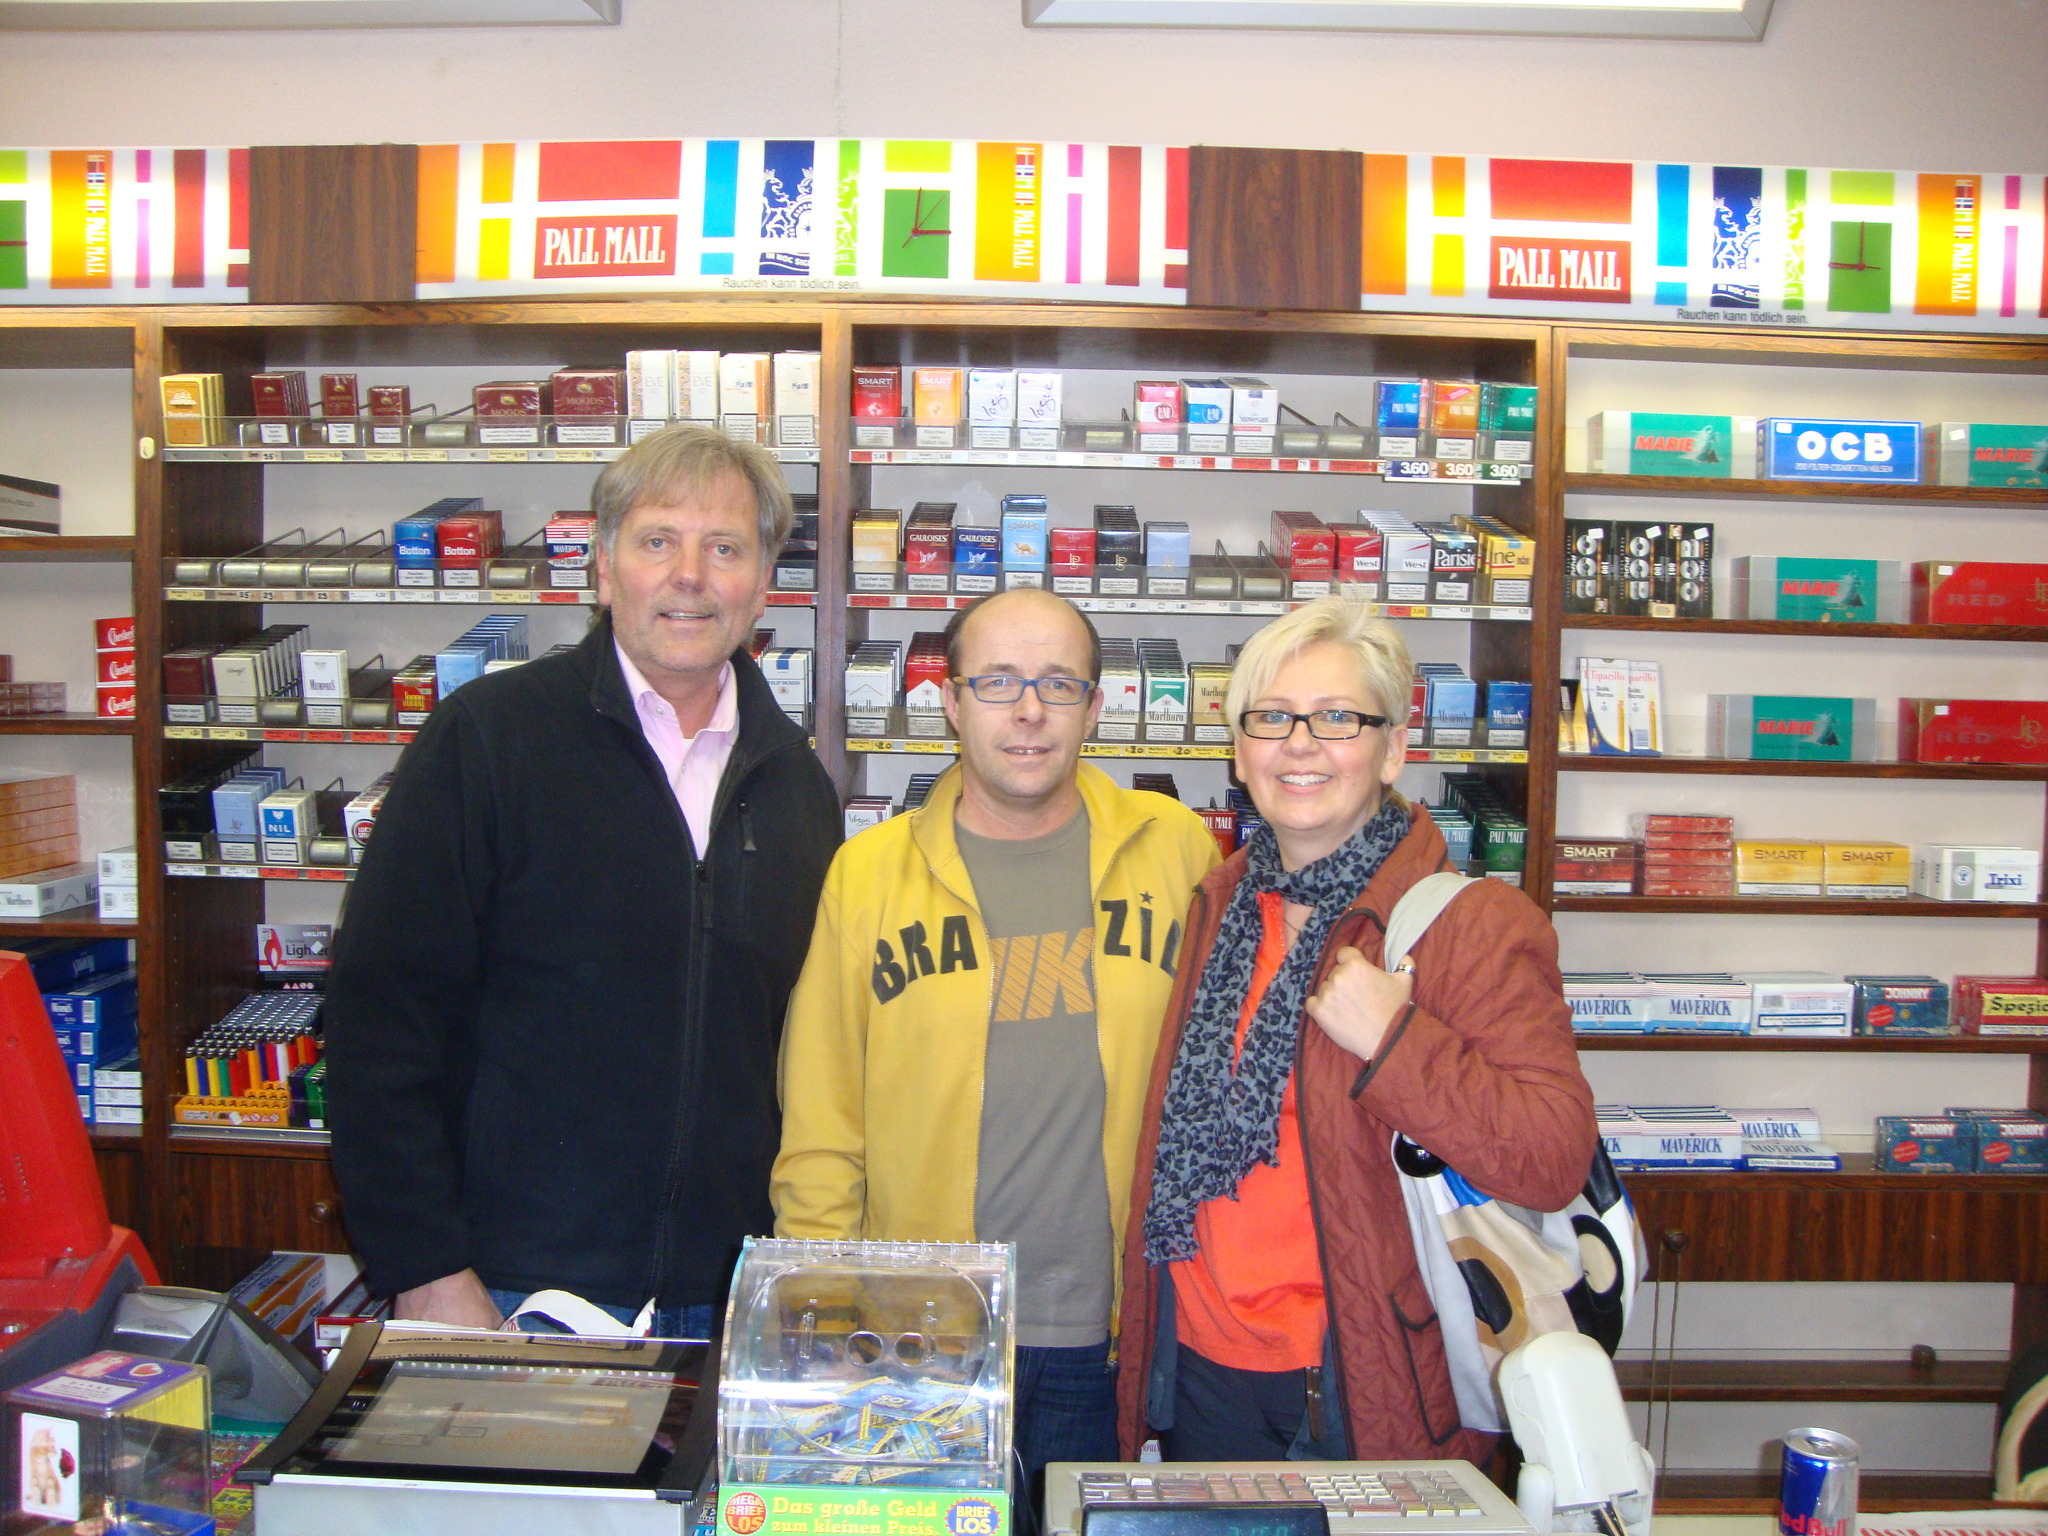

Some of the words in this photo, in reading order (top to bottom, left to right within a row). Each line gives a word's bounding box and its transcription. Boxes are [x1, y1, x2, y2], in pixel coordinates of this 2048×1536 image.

[86, 217, 106, 244] PALL
[1013, 210, 1035, 237] PALL
[544, 227, 599, 266] PALL
[604, 225, 665, 264] MALL
[1013, 238, 1034, 268] MALL
[1952, 243, 1974, 270] PALL
[86, 246, 106, 276] MALL
[1499, 247, 1555, 288] PALL
[1560, 249, 1621, 291] MALL
[722, 277, 767, 290] Rauchen
[771, 278, 797, 290] kann
[800, 278, 834, 290] tödlich
[838, 279, 862, 290] sein.
[1951, 273, 1973, 303] MALL
[1677, 308, 1719, 320] Rauchen
[1723, 310, 1746, 321] kann
[1750, 310, 1782, 323] tödlich
[1786, 314, 1808, 324] sein.
[1636, 436, 1695, 452] MARIE
[1797, 430, 1893, 461] OCB
[1975, 447, 2035, 463] MARIE
[910, 534, 948, 542] GAULOISES
[959, 534, 996, 542] GAULOISES
[1404, 560, 1427, 568] West
[1782, 581, 1840, 596] MARIE
[1949, 594, 2006, 606] RED
[309, 680, 335, 691] MEMPHIS
[852, 699, 886, 713] Marlboro
[1105, 703, 1135, 716] Marlboro
[1150, 707, 1184, 722] Marlboro
[1493, 709, 1524, 724] MEMPHIS
[1757, 720, 1815, 734] MARIE
[1937, 732, 1994, 744] RED
[268, 824, 291, 833] NIL
[1214, 817, 1232, 829] MALL
[1451, 831, 1468, 842] MALL
[1490, 831, 1505, 843] PALL
[1507, 831, 1524, 843] MALL
[1563, 846, 1618, 858] SMART
[1753, 850, 1807, 861] SMART
[1842, 851, 1895, 862] SMART
[1988, 873, 2022, 885] Trixi
[871, 914, 978, 1004] BRA
[1885, 987, 1931, 1000] JOHNNY
[1569, 1000, 1632, 1015] MAVERICK
[1669, 999, 1731, 1016] MAVERICK
[1741, 1122, 1801, 1138] MAVERICK
[1910, 1123, 1956, 1136] JOHNNY
[2001, 1124, 2046, 1137] JOHNNY
[1660, 1138, 1722, 1153] MAVERICK
[1752, 1144, 1815, 1153] MAVERICK
[729, 1494, 762, 1506] MEGA
[727, 1505, 764, 1516] BRIEF
[772, 1497, 814, 1514] Das
[820, 1499, 881, 1519] große
[887, 1500, 937, 1518] Geld
[956, 1505, 991, 1518] BRIEF
[728, 1516, 764, 1533] LOS
[771, 1519, 808, 1533] zum
[814, 1518, 881, 1535] kleinen
[887, 1520, 939, 1536] Preis.
[955, 1518, 991, 1534] LOS
[1782, 1515, 1806, 1532] ed
[1808, 1517, 1848, 1536] Bull
